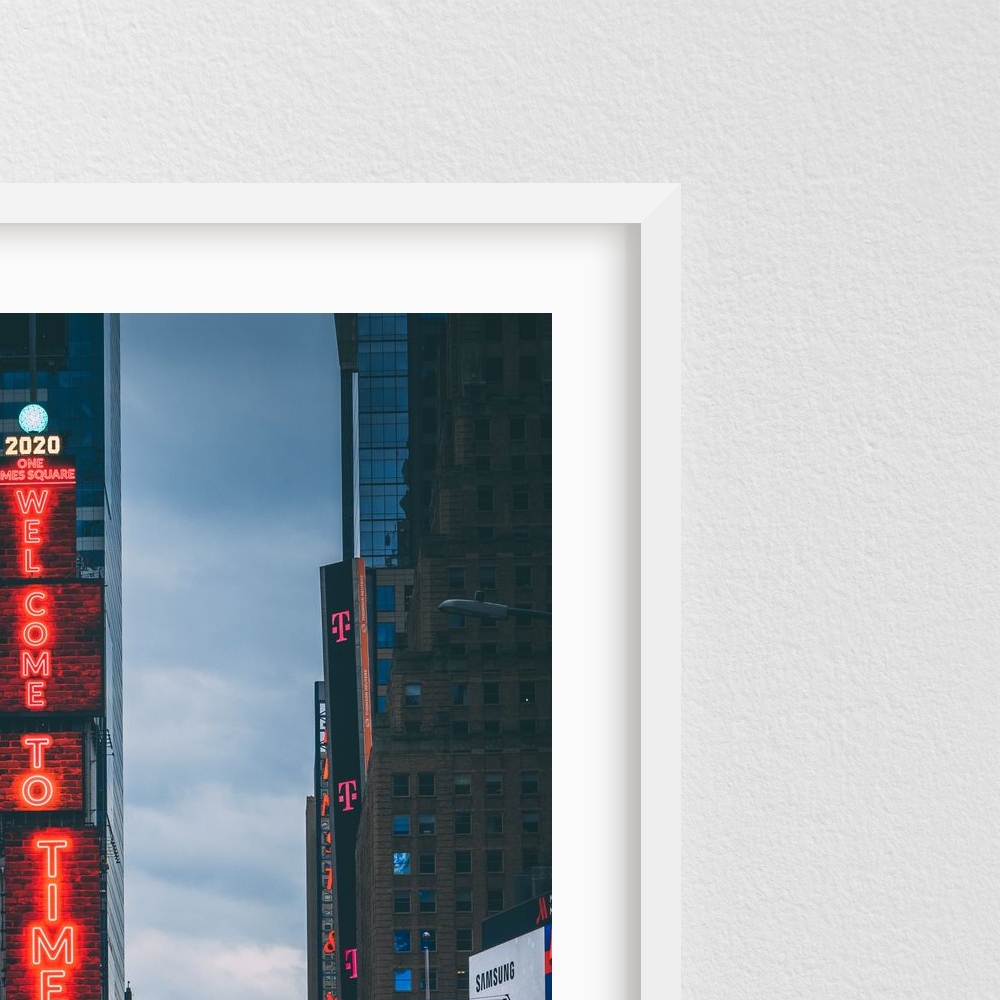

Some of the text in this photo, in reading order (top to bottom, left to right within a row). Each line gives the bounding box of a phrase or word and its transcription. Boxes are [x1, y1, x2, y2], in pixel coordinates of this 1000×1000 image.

[5, 435, 61, 456] 2020
[17, 458, 44, 469] ONE
[27, 468, 76, 481] SQUARE
[22, 737, 53, 807] TO
[475, 960, 516, 993] SAMSUNG
